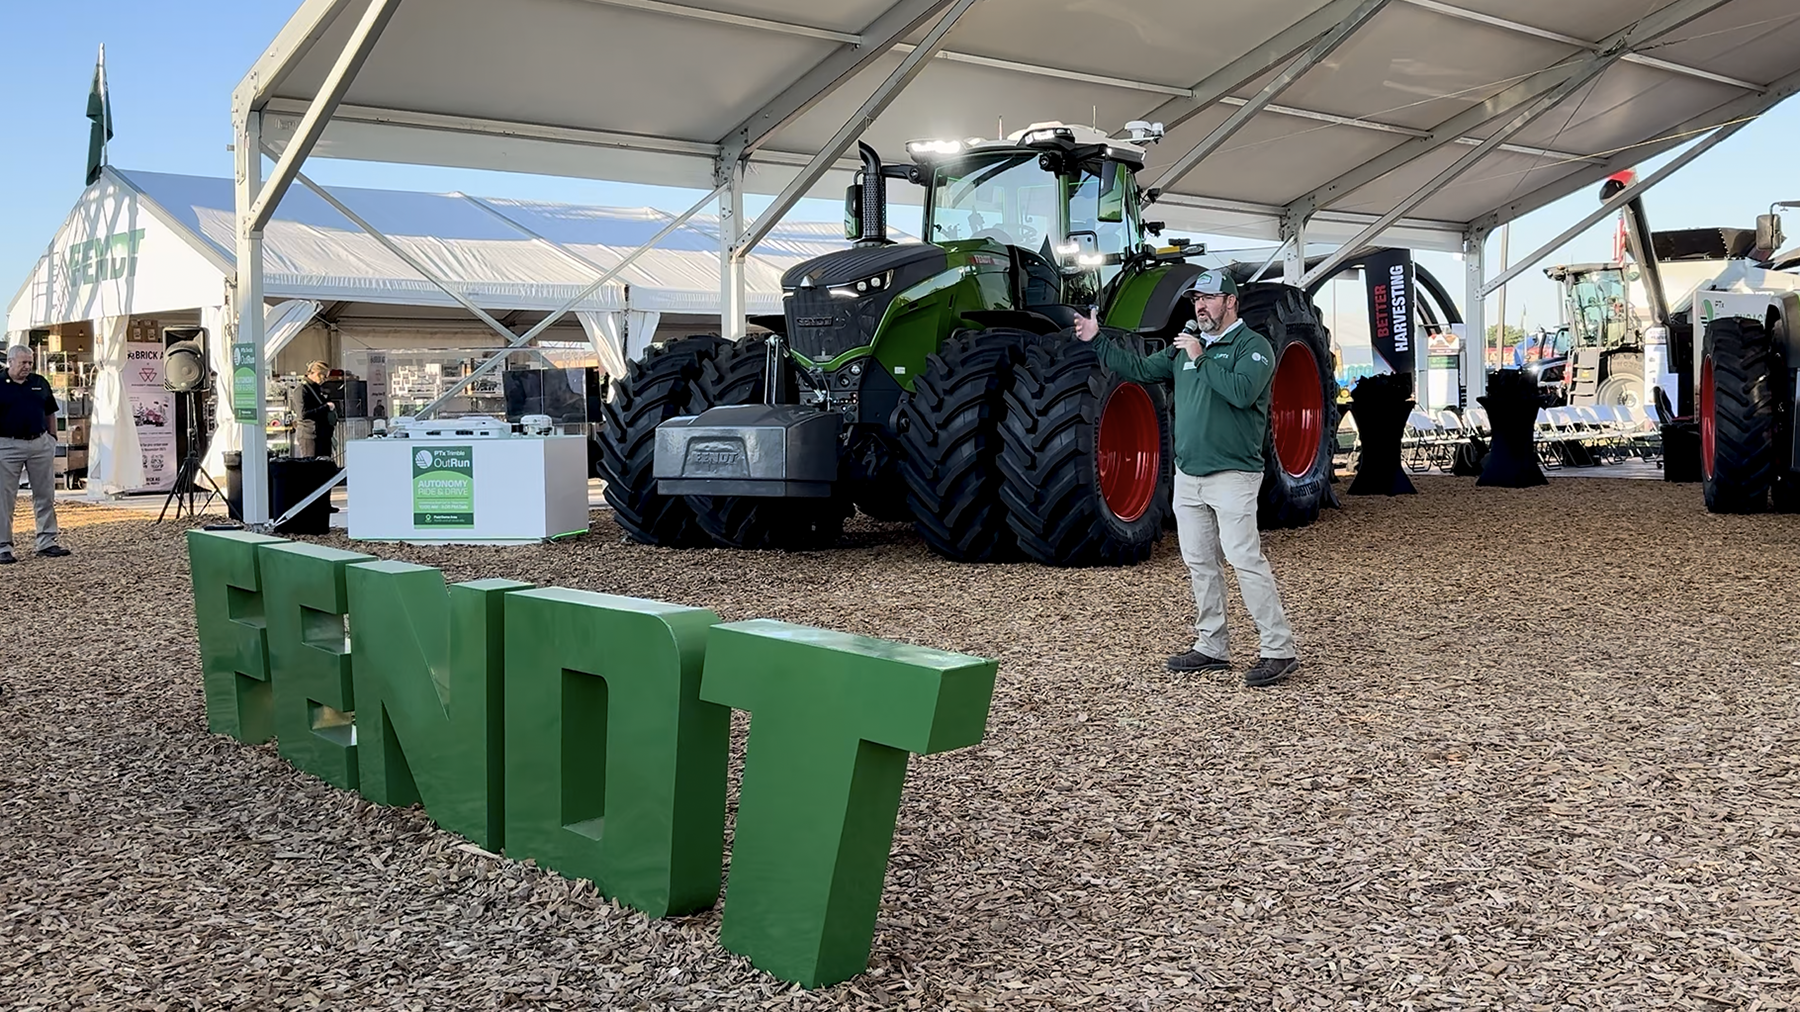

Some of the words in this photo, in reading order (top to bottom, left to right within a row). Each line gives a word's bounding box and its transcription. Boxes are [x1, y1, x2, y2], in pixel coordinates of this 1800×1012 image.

[69, 228, 146, 286] FENDT
[1374, 284, 1390, 338] BETTER
[1390, 264, 1409, 352] HARVESTING
[434, 458, 470, 467] OutRun
[695, 452, 738, 464] FENDT
[187, 528, 998, 989] FENDT
